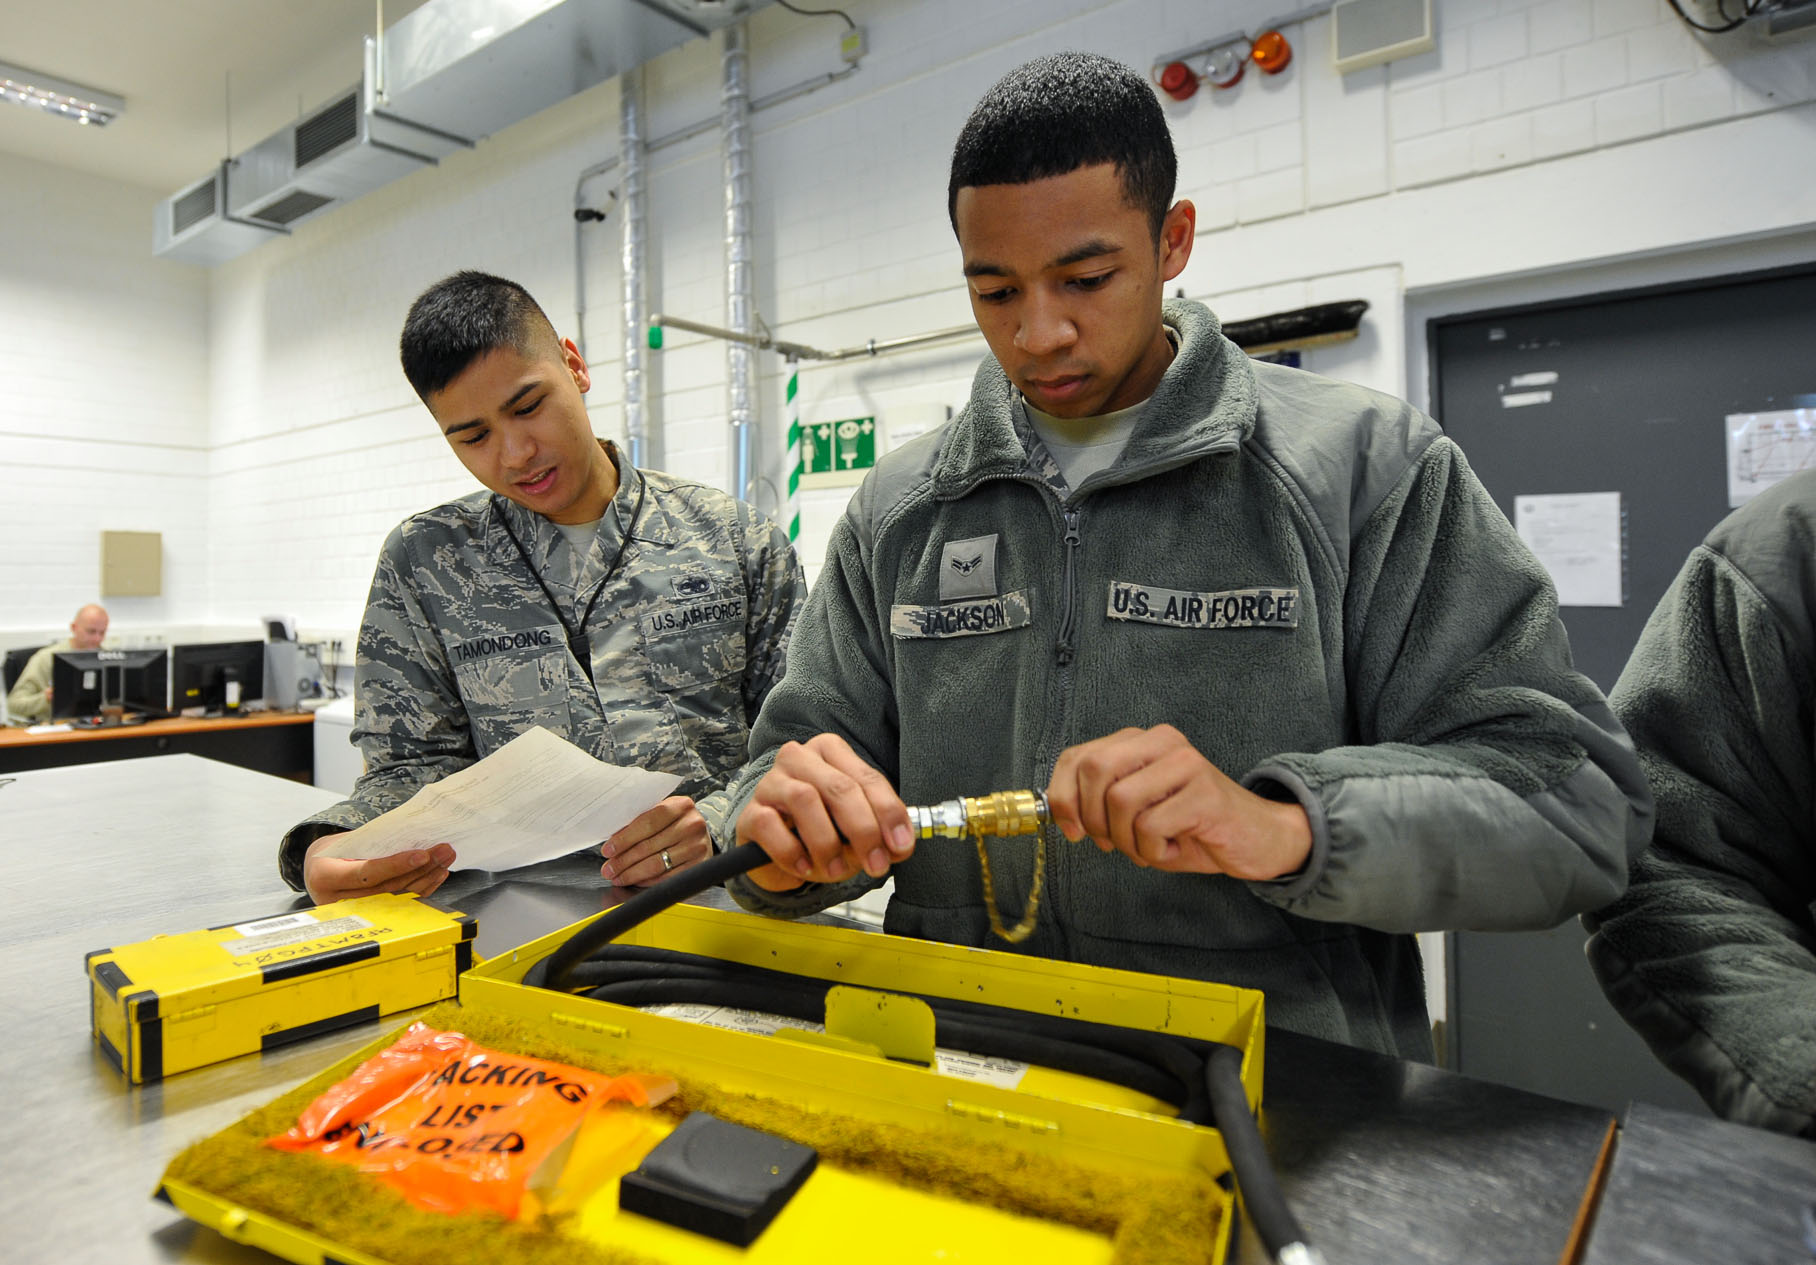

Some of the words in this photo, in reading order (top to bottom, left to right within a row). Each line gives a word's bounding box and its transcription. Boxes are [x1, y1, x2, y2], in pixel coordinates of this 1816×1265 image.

[652, 613, 679, 631] U.S.
[682, 607, 703, 627] AIR
[704, 602, 742, 621] FORCE
[921, 599, 1005, 634] JACKSON
[1114, 588, 1155, 617] U.S.
[1164, 596, 1203, 623] AIR
[1210, 595, 1294, 623] FORCE
[453, 630, 551, 660] TAMONDONG
[431, 1060, 588, 1104] ACKING
